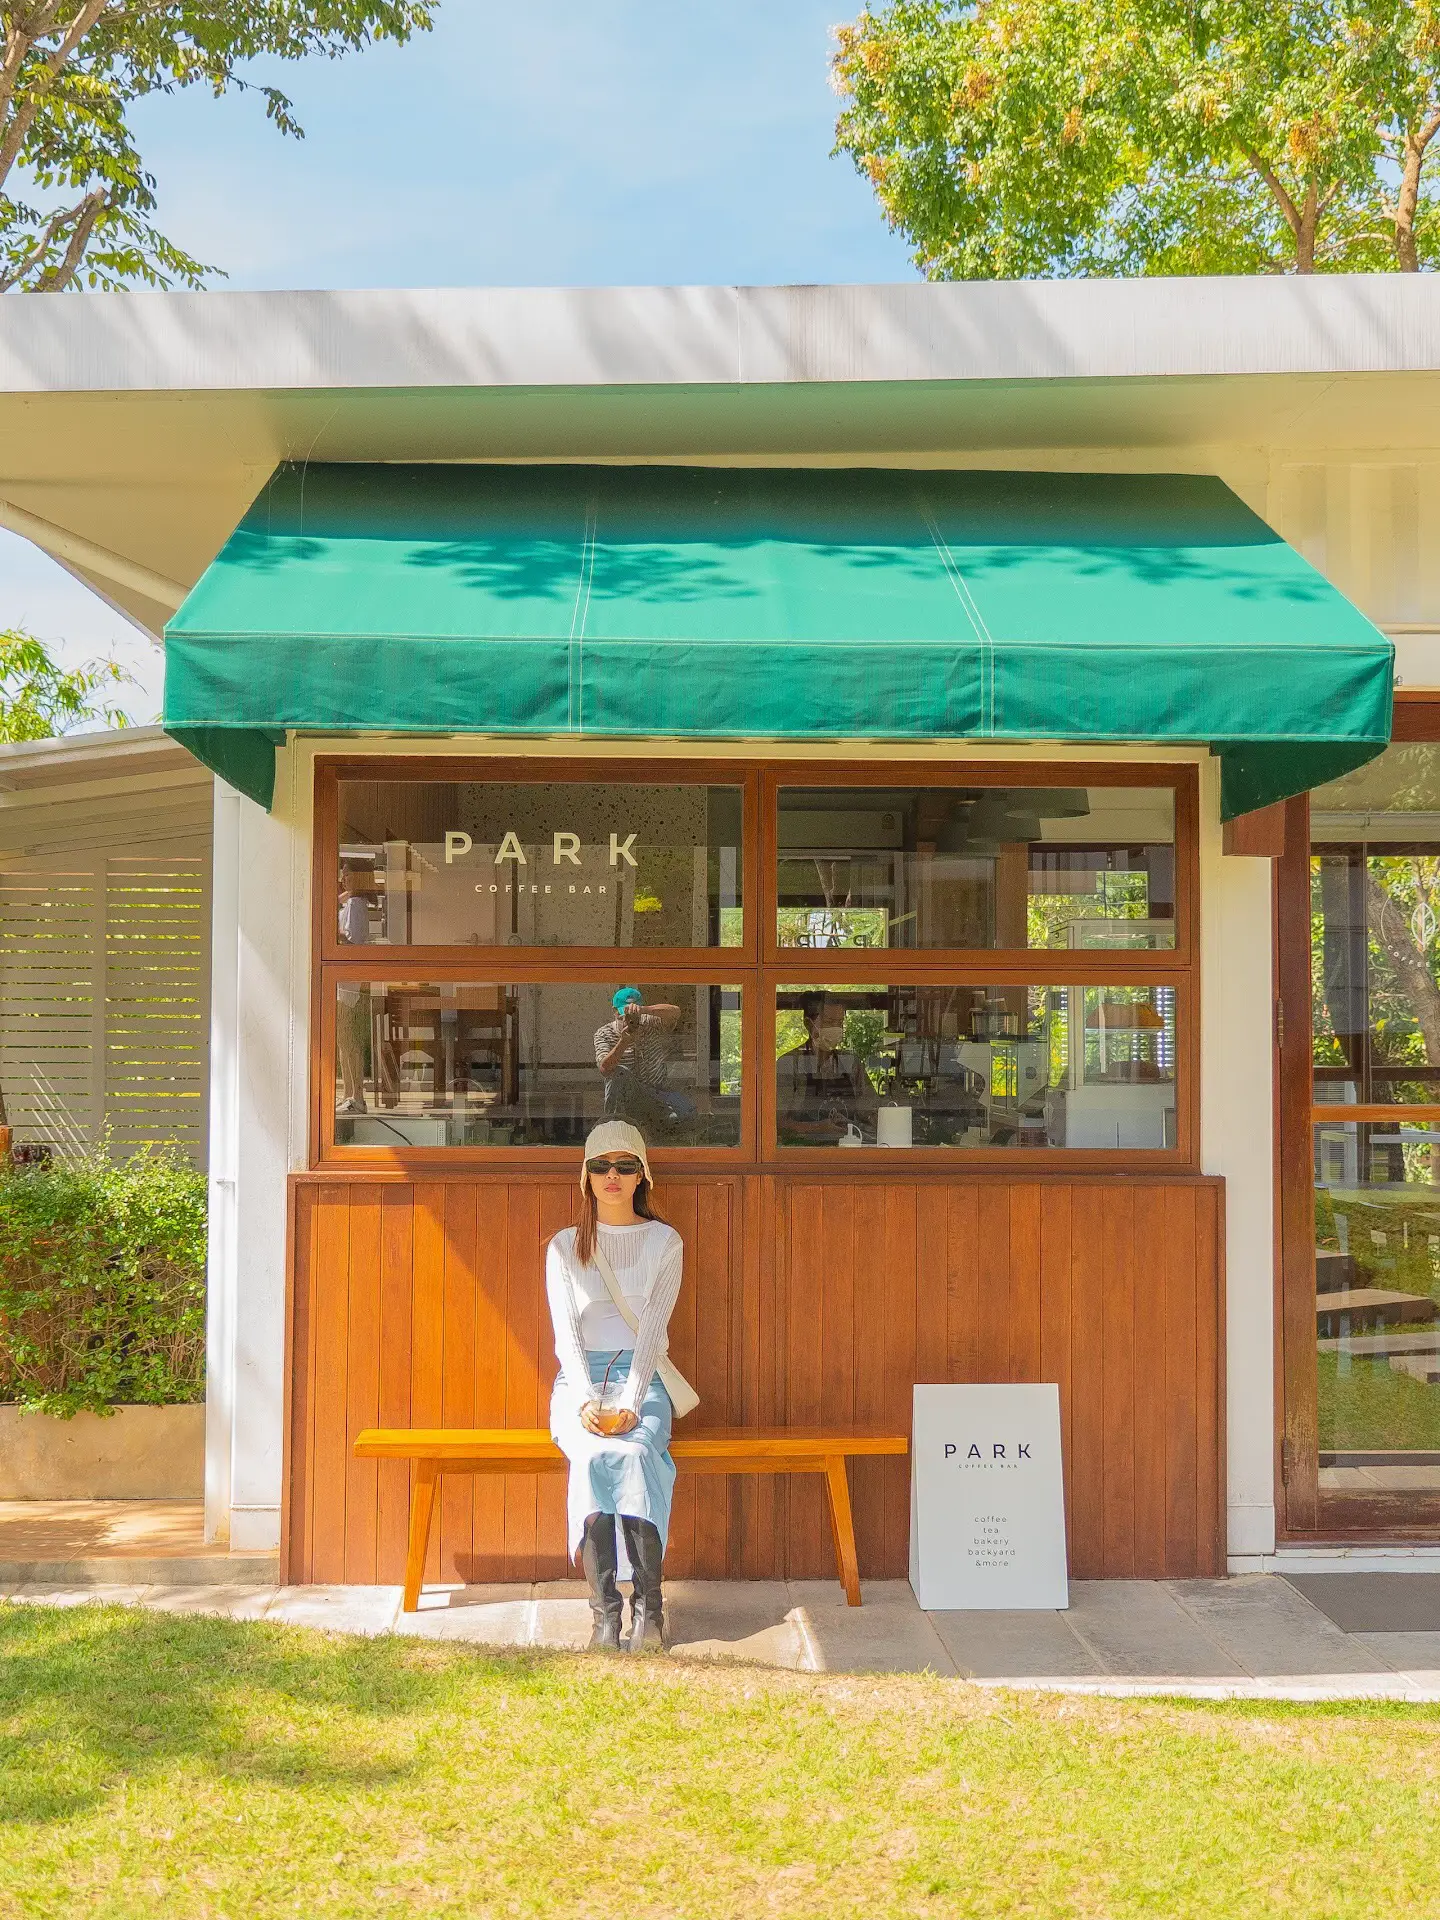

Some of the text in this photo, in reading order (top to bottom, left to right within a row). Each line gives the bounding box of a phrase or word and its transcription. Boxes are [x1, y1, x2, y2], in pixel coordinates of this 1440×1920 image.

[445, 831, 638, 866] PARK
[474, 884, 607, 894] COFFEE BAR
[1387, 944, 1431, 968] COFFEE
[944, 1443, 1032, 1459] PARK
[974, 1515, 1007, 1523] coffee
[973, 1537, 1009, 1546] bakery
[967, 1548, 1016, 1557] backyard
[975, 1559, 1009, 1567] &more
